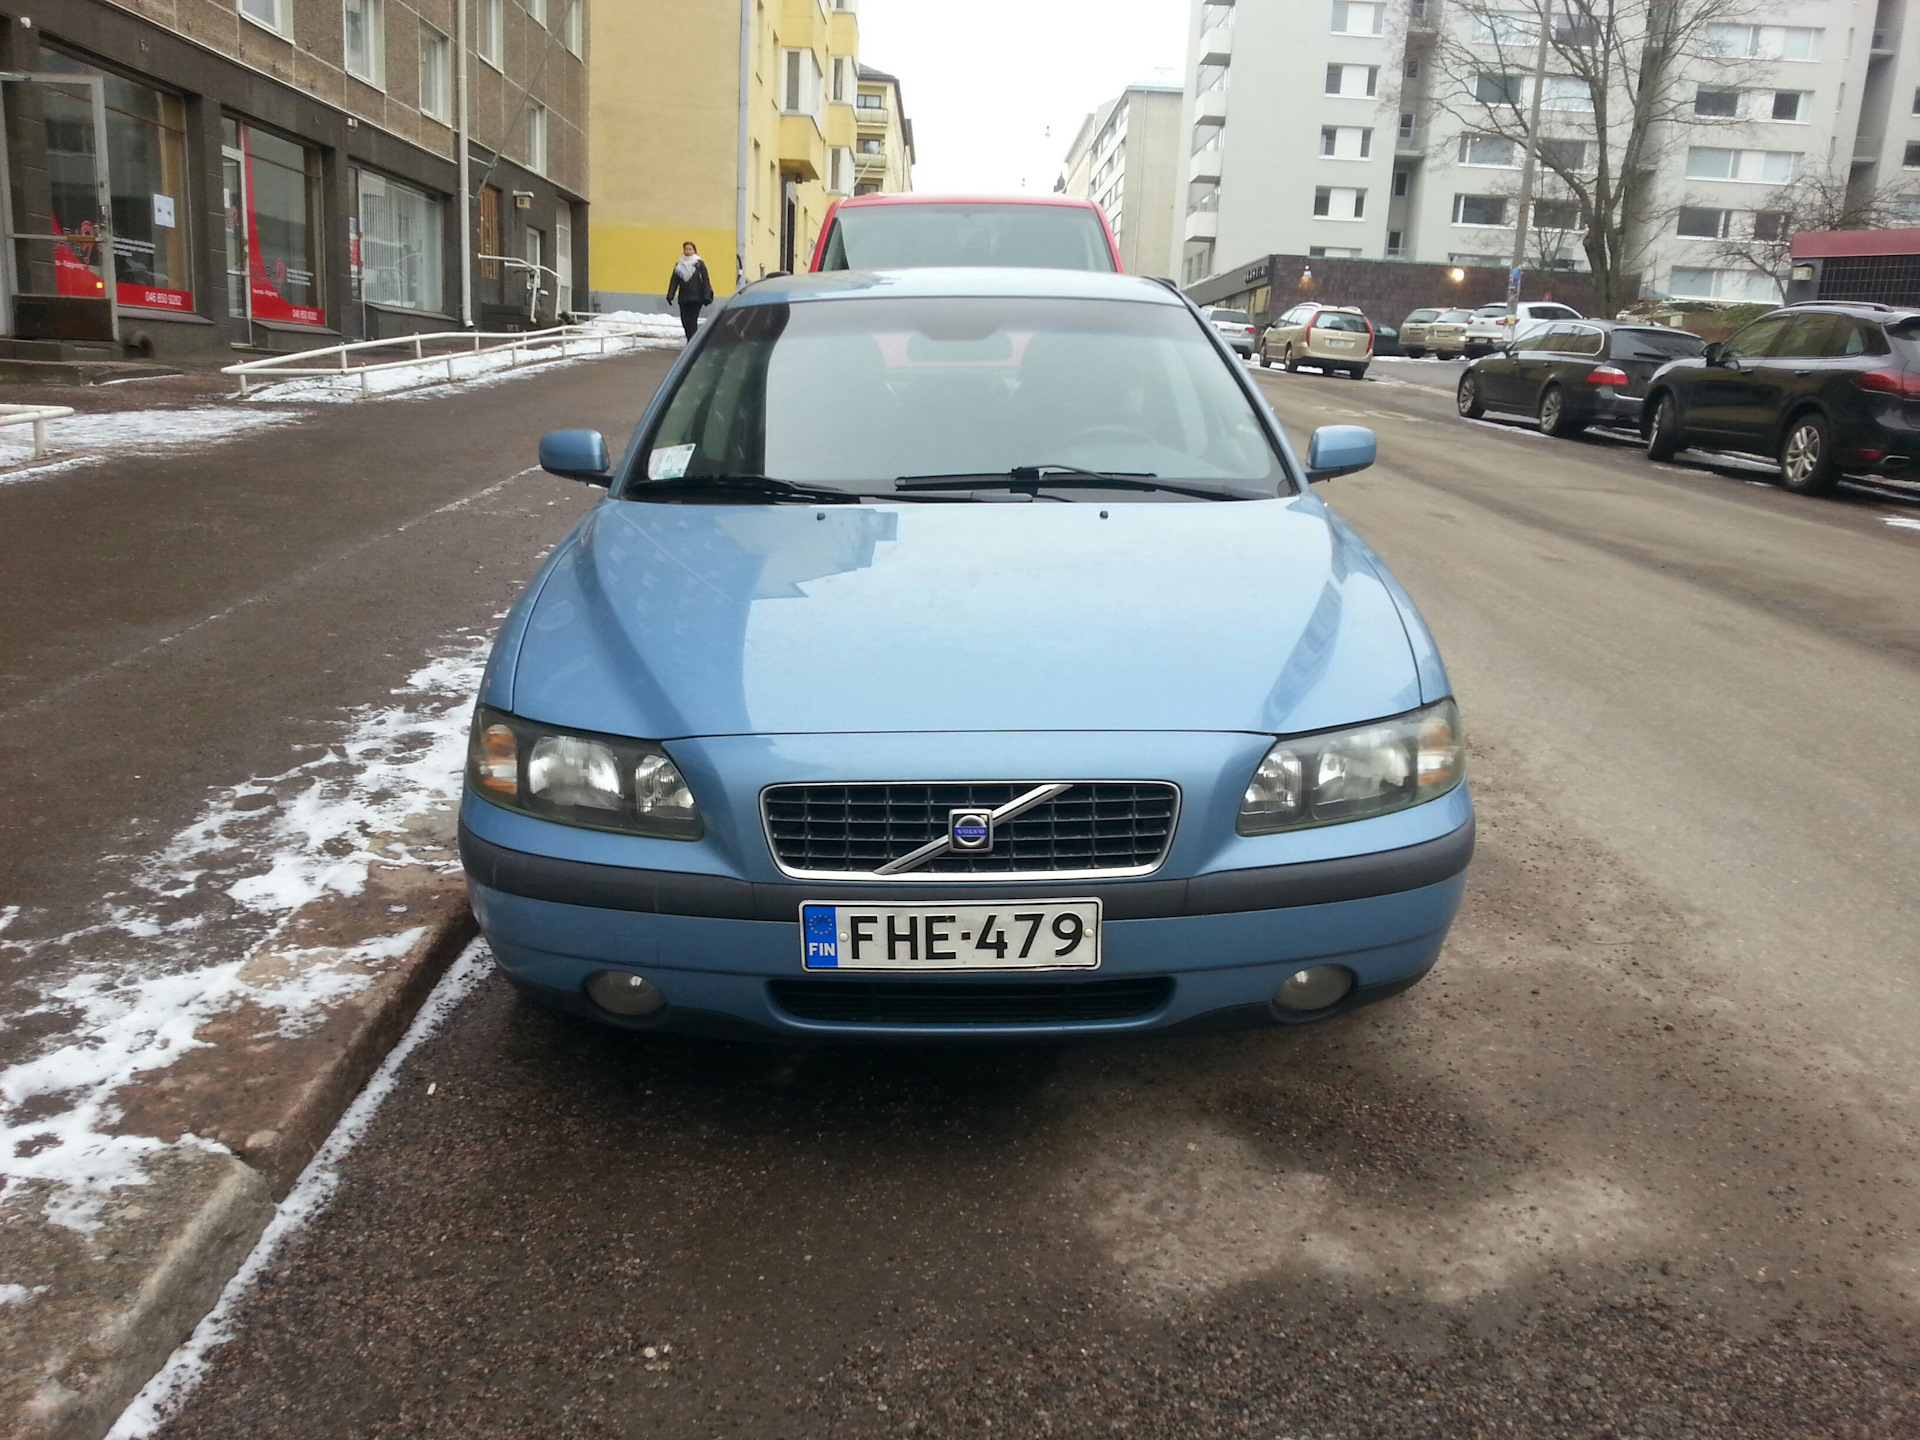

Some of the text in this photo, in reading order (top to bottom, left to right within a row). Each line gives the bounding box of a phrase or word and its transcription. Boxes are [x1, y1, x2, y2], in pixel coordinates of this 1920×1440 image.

[145, 290, 157, 302] 046
[157, 292, 168, 304] 850
[808, 942, 836, 957] FIN
